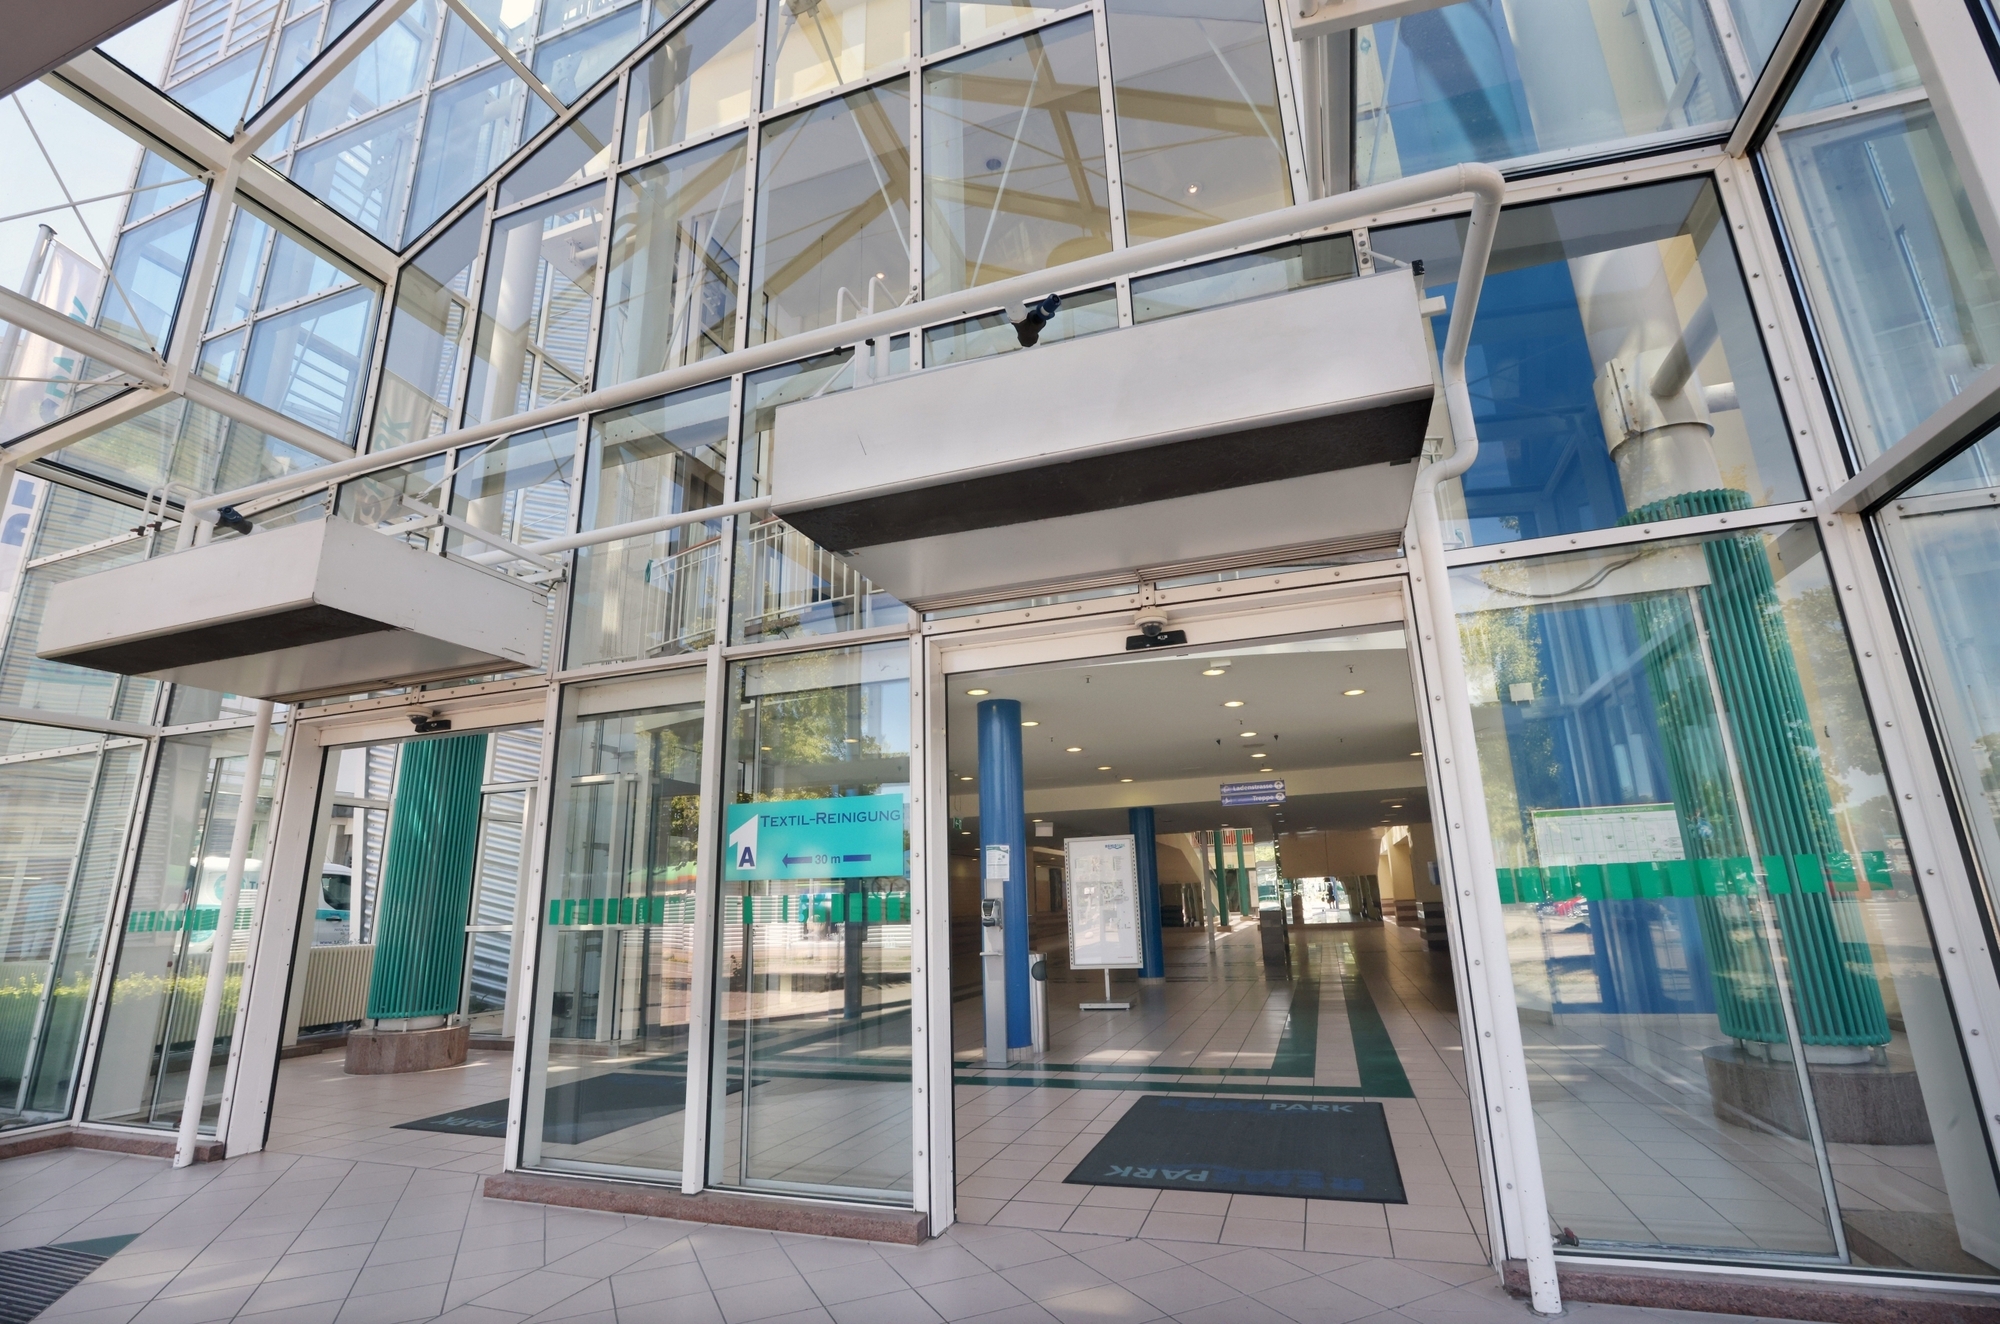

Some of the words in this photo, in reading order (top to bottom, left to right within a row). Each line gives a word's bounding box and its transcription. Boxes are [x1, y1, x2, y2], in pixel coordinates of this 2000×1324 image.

[760, 810, 900, 828] TEXTIL-REINIGUNG
[814, 855, 828, 864] 30
[830, 856, 841, 864] m
